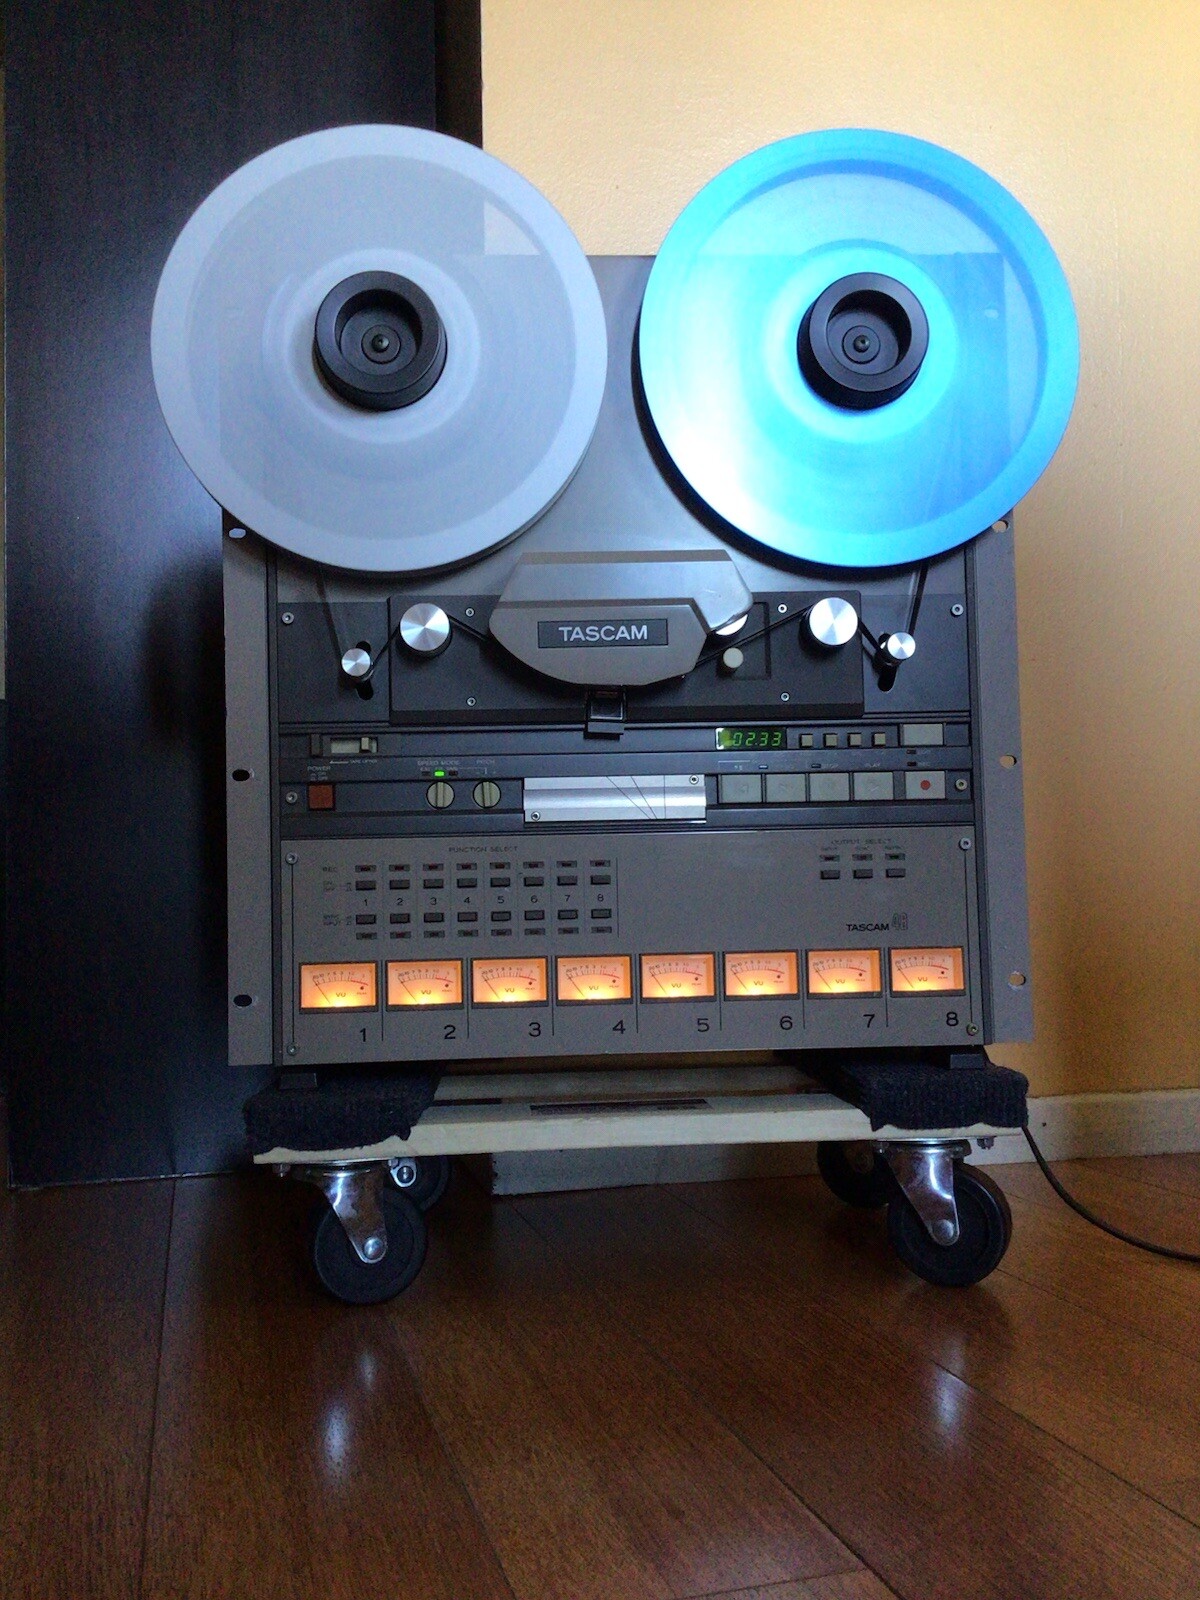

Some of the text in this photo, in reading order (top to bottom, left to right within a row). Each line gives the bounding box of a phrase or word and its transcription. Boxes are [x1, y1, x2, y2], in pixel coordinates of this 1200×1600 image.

[558, 624, 648, 642] TASCAM
[363, 894, 604, 906] 1 2 3 4 5 6 7 8
[846, 923, 889, 931] TASCAM
[360, 1011, 960, 1042] 1 2 3 4 5 6 7 8
